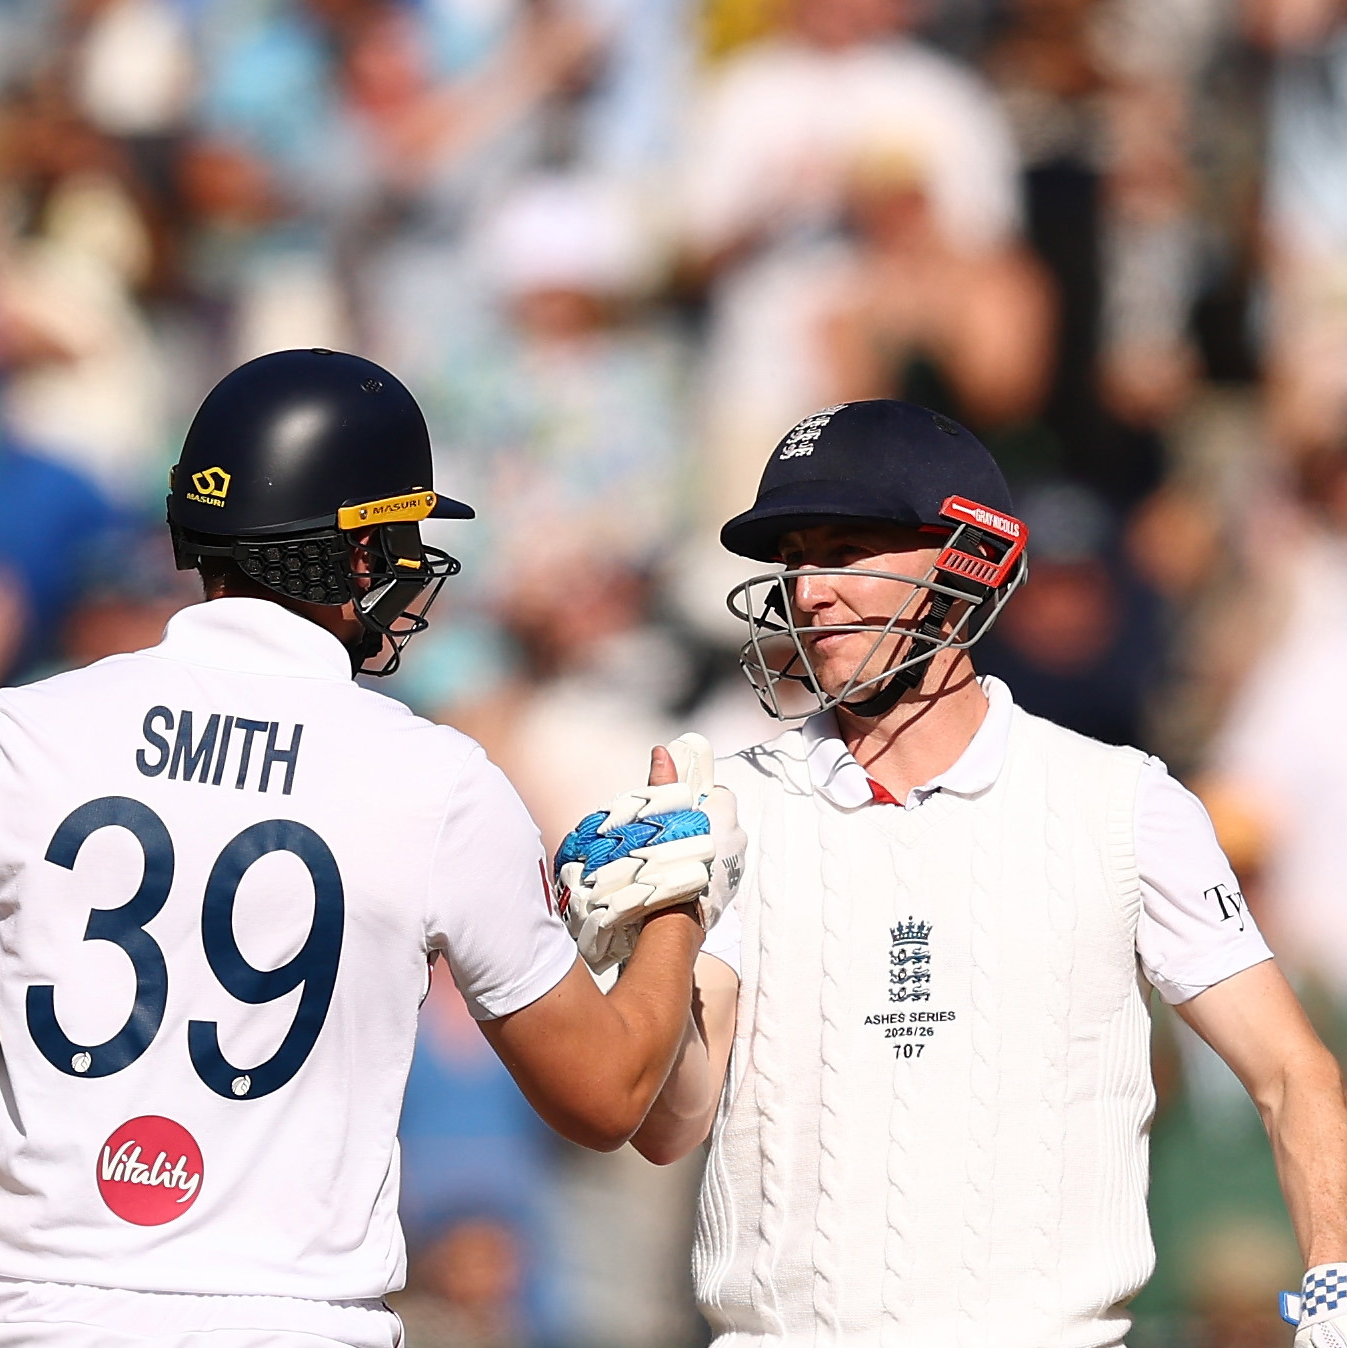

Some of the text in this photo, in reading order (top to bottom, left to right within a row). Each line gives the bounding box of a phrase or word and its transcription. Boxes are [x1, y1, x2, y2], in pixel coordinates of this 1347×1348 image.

[187, 492, 225, 508] MASURI
[373, 499, 421, 514] MASURI
[135, 705, 304, 796] SMITH
[25, 796, 345, 1100] 39
[864, 1010, 956, 1026] ASHES SERIES
[884, 1027, 935, 1039] 2025/26
[893, 1044, 925, 1059] 707
[102, 1139, 201, 1203] Vitality
